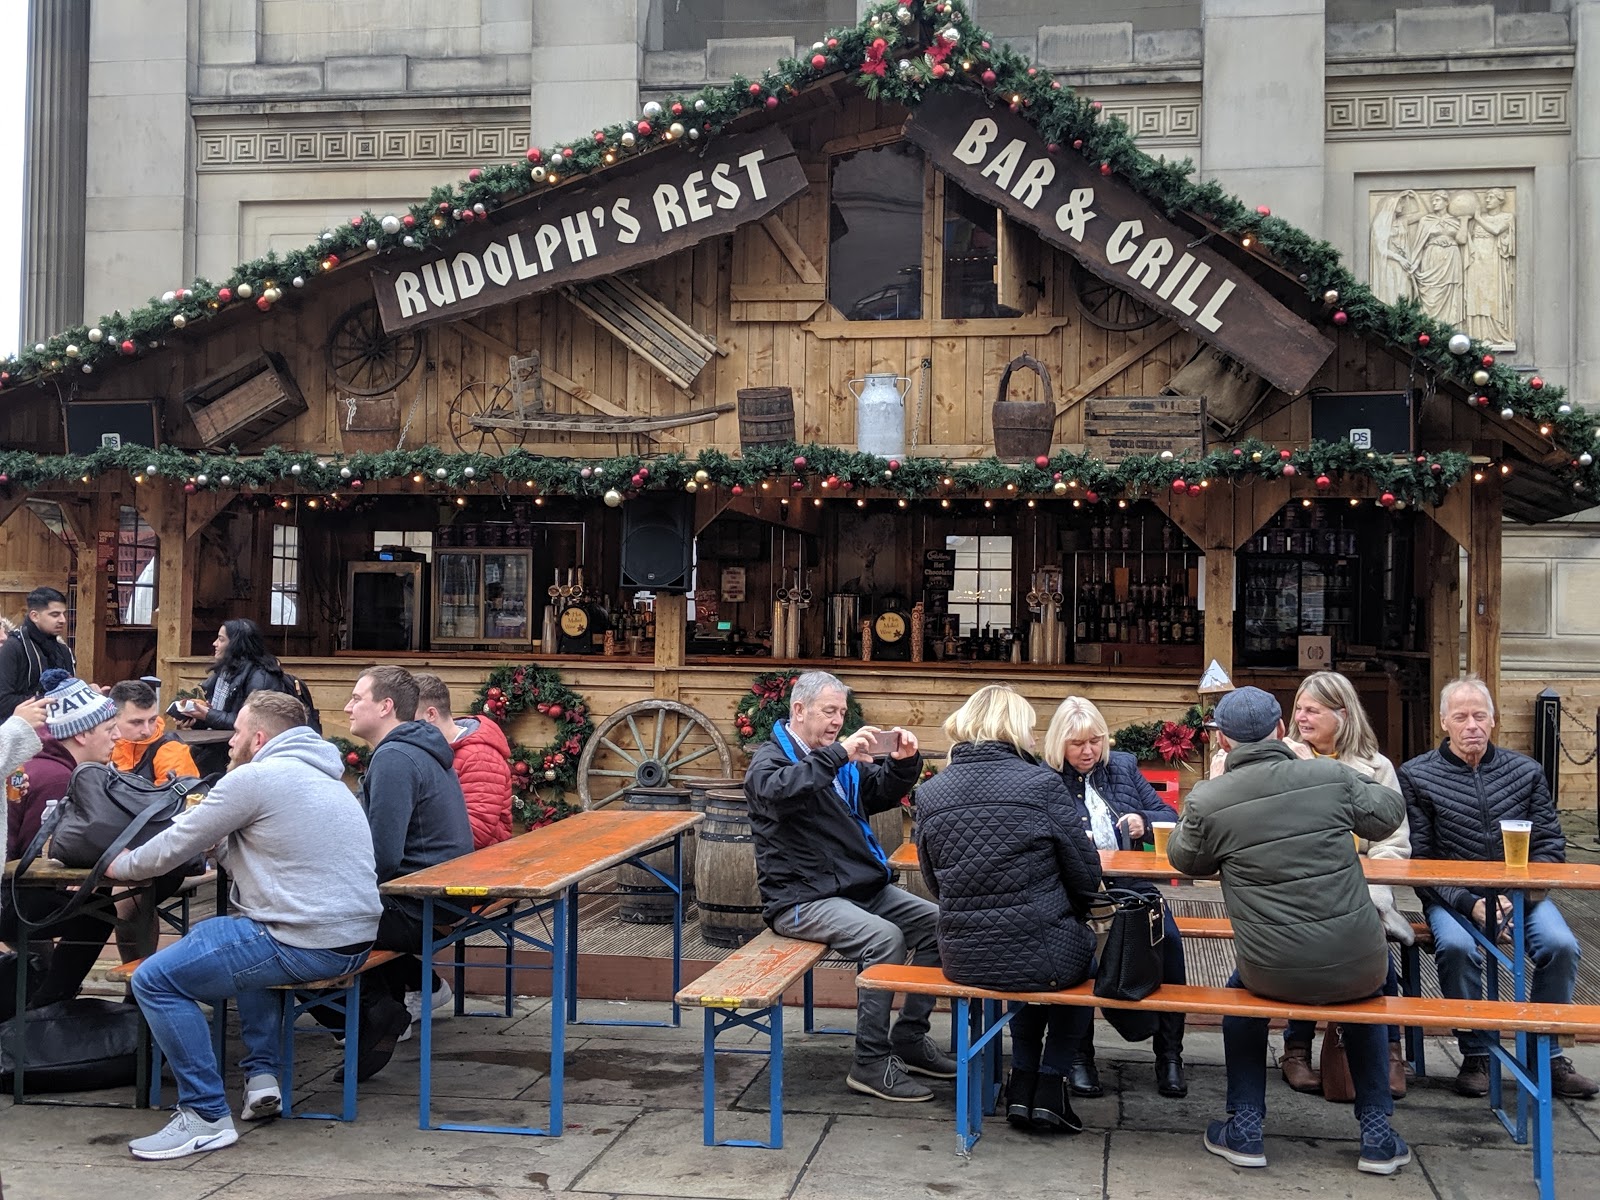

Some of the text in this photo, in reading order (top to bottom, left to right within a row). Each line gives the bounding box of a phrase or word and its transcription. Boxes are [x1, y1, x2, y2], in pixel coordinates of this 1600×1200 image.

[394, 149, 768, 318] RUDOLPH'S REST
[952, 117, 1237, 333] BAR & GRILL
[1353, 432, 1368, 442] DS
